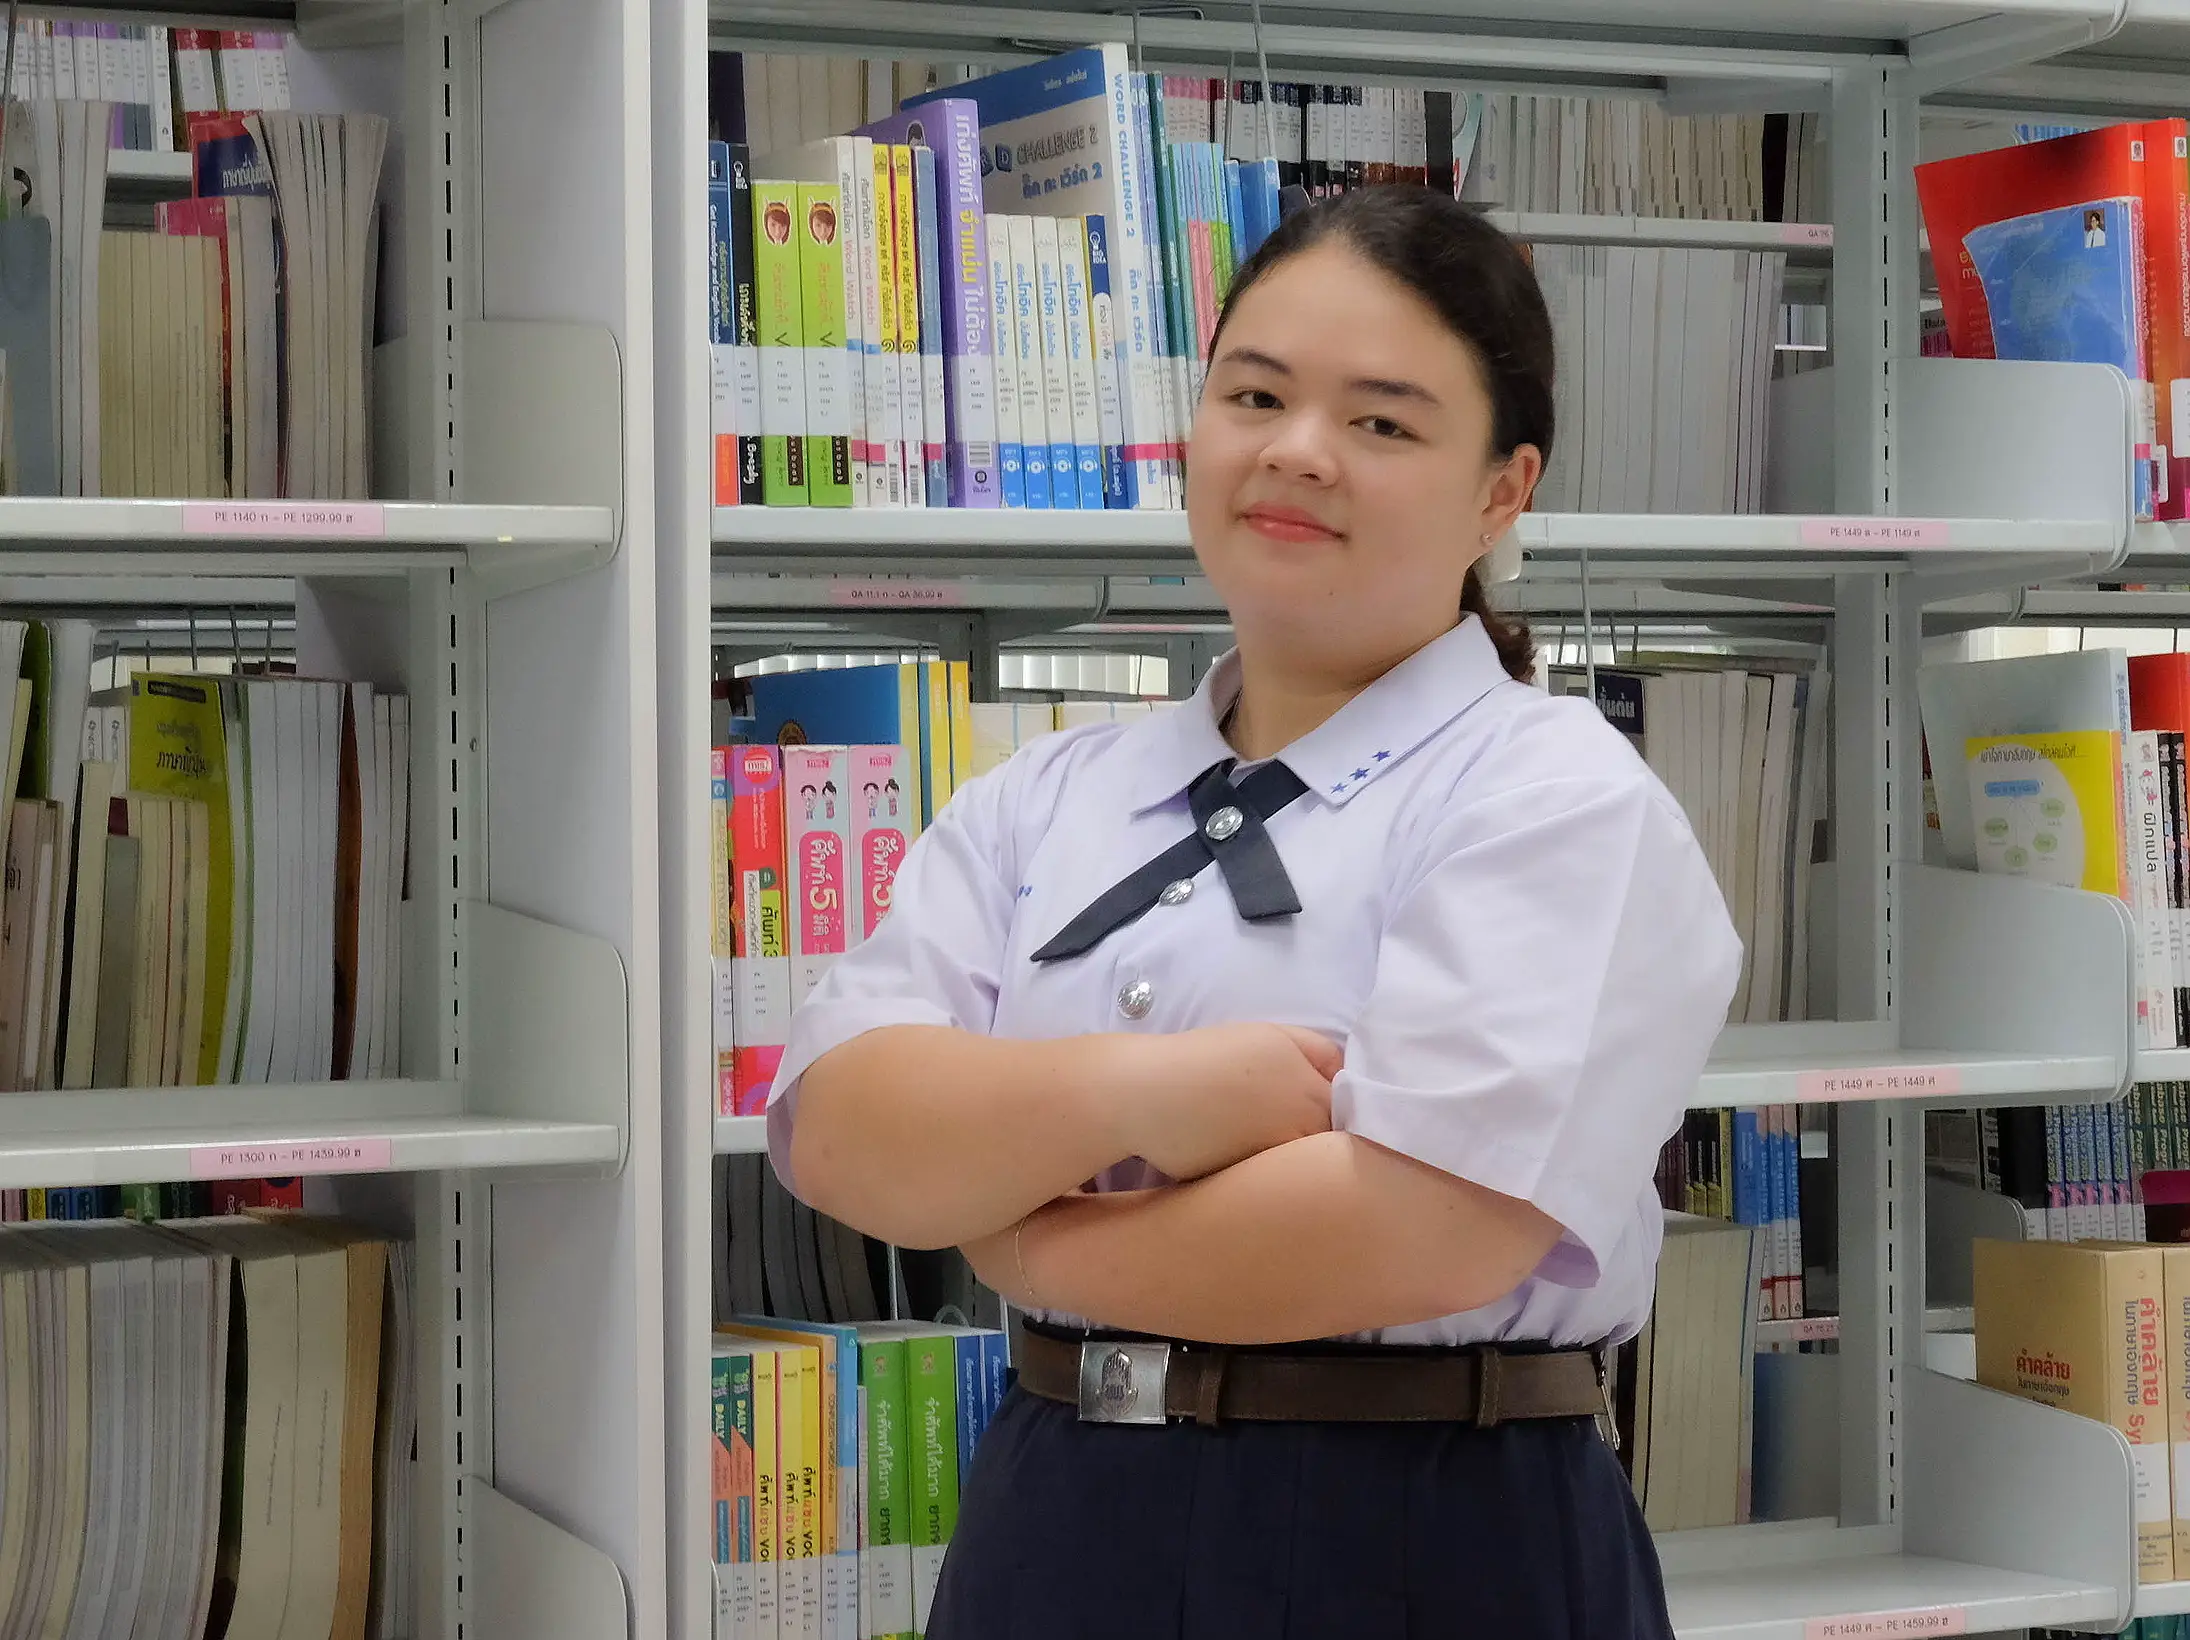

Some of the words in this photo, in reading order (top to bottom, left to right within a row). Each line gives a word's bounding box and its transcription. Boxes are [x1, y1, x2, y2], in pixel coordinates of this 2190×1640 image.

[1114, 74, 1126, 125] WORD
[1017, 126, 1086, 165] CHALLENGE
[1090, 125, 1098, 144] 2
[1119, 129, 1134, 222] CHALLENGE
[959, 209, 983, 284] จำแม่น
[1126, 228, 1136, 238] 2
[215, 512, 226, 521] PE
[234, 512, 256, 521] 1140
[283, 512, 294, 521] PE
[302, 512, 341, 522] 1299.99
[1830, 527, 1839, 536] PE
[1844, 527, 1862, 537] 1449
[1881, 528, 1889, 537] PE
[809, 886, 837, 910] 5
[762, 907, 778, 945] ศัพท์
[1824, 1080, 1836, 1090] PE
[1840, 1079, 1861, 1089] 1449
[1888, 1076, 1899, 1088] PE
[1904, 1076, 1924, 1087] 1449
[221, 1152, 232, 1164] PE
[240, 1152, 264, 1162] 1300
[292, 1149, 303, 1160] PE
[310, 1148, 351, 1160] 1439.99
[2016, 1348, 2072, 1380] คำคล้าย
[2124, 1299, 2139, 1406] ในภาษาอังกฤษ
[2140, 1298, 2164, 1406] คำคล้าย
[715, 1403, 724, 1439] DAILY
[737, 1400, 746, 1435] DAILY
[1823, 1626, 1836, 1636] PE
[1840, 1623, 1861, 1634] 1449
[1886, 1619, 1898, 1631] PE
